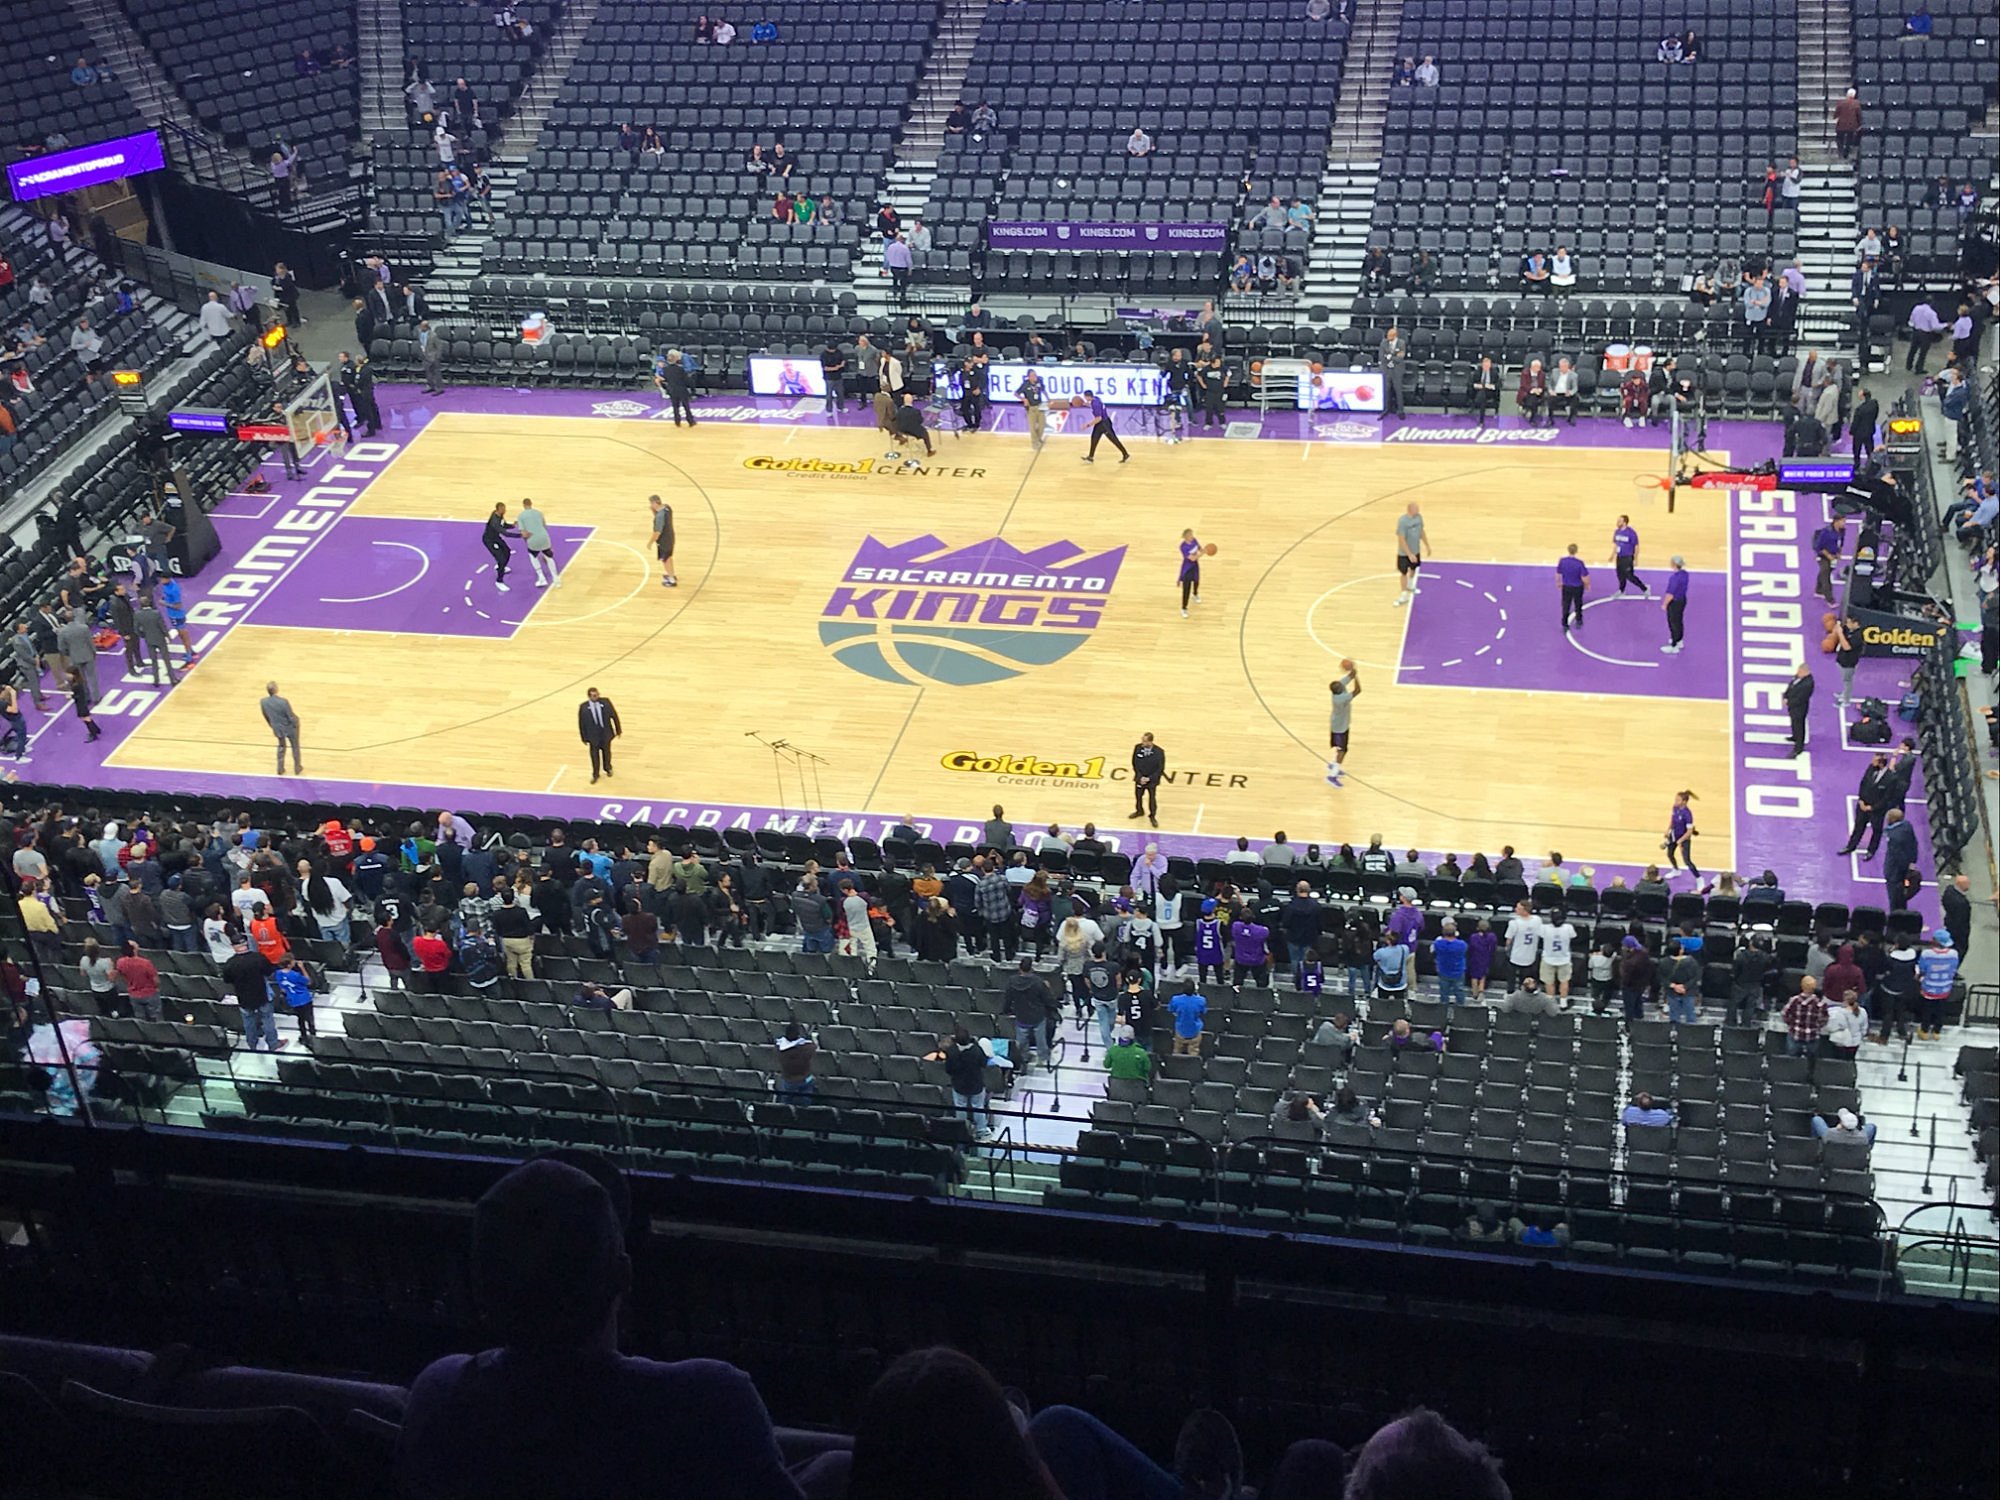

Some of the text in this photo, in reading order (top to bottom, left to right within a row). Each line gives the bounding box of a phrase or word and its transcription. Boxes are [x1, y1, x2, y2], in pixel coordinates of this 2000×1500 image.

[993, 227, 1048, 237] KINGS.COM
[1080, 228, 1135, 238] KINGS.COM
[1169, 228, 1225, 239] KINGS.COM
[1095, 378, 1117, 395] IS
[1386, 425, 1480, 442] Almond
[1476, 426, 1559, 443] Breeze
[786, 471, 868, 481] Credit Union
[851, 567, 1106, 590] SACRAMENTO
[821, 587, 1108, 629] KINGS
[1863, 626, 1934, 646] Golden
[1739, 490, 1815, 819] SACRAMENTO
[997, 774, 1100, 790] Credit Union
[1109, 767, 1249, 788] CNTER
[386, 904, 399, 920] 3
[1164, 908, 1172, 920] 0
[1135, 937, 1147, 950] 4
[1202, 936, 1214, 949] 5
[1524, 933, 1533, 945] 5
[1552, 940, 1562, 952] 5
[1306, 975, 1317, 987] 5
[1130, 1006, 1142, 1020] 5
